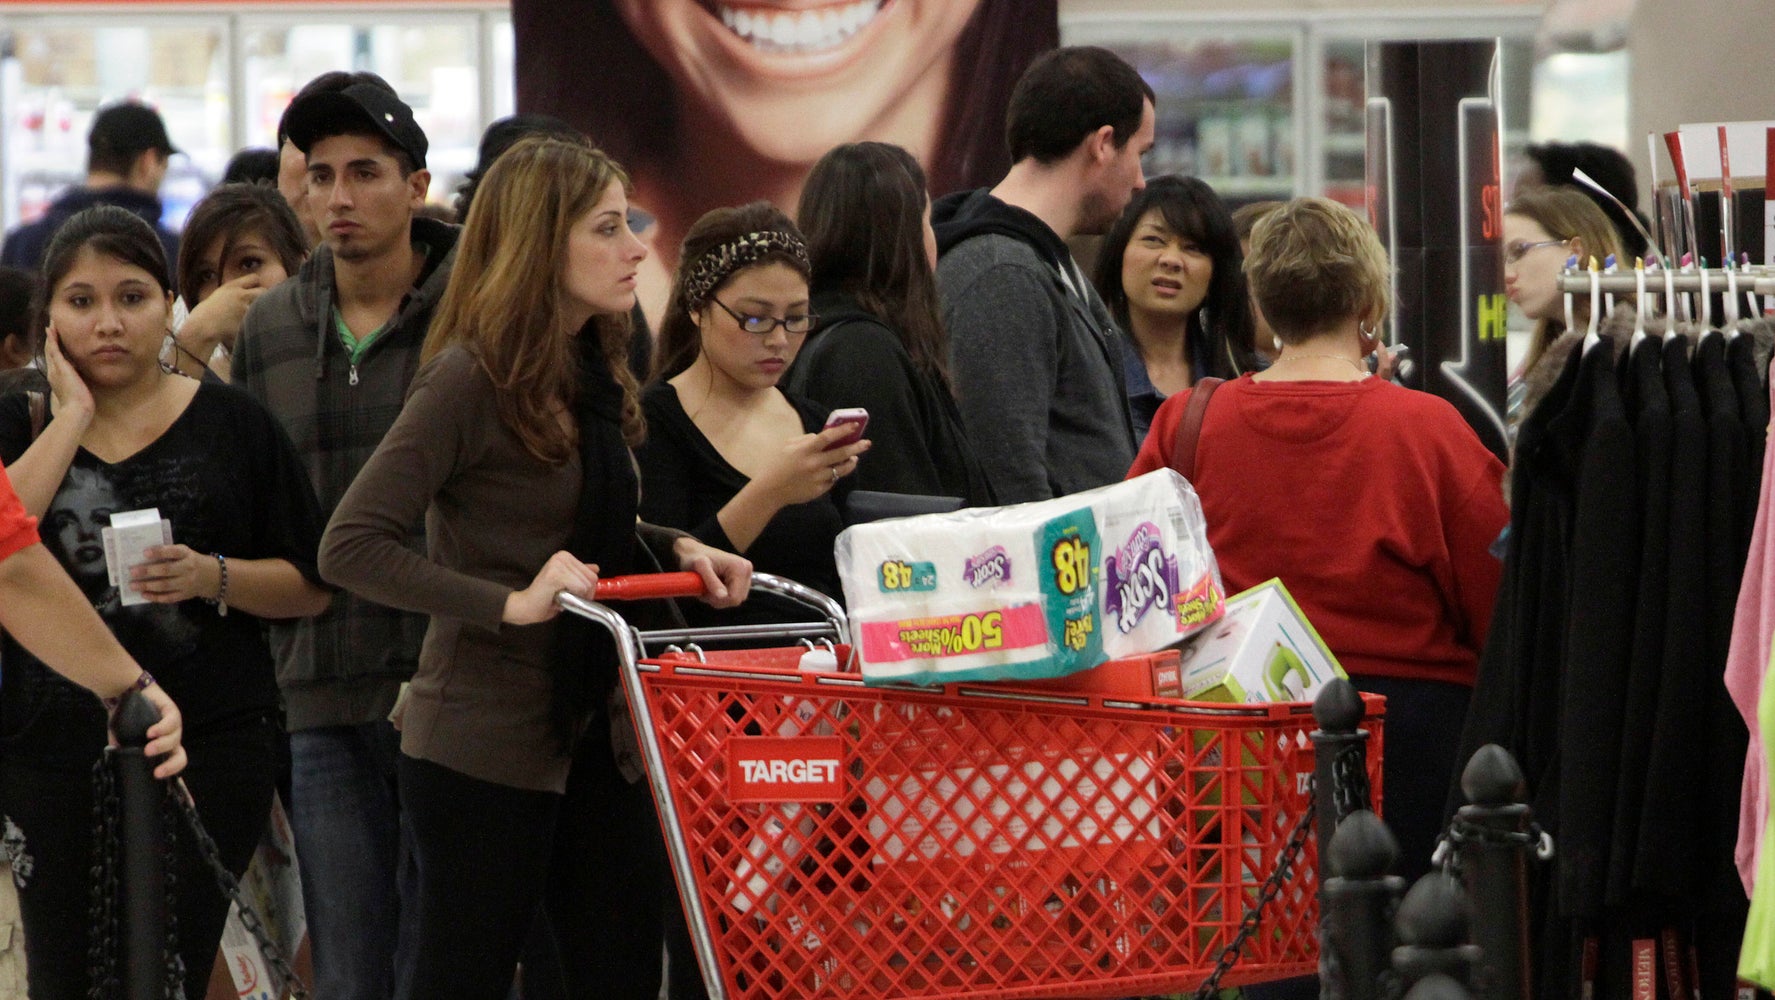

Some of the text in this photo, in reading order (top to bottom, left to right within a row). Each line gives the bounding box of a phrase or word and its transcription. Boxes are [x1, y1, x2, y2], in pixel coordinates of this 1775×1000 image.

[882, 561, 912, 590] 48
[971, 556, 1005, 590] Scott
[1052, 535, 1090, 597] 48
[1117, 548, 1168, 635] Scott
[899, 628, 941, 643] Sheets
[911, 611, 1003, 656] 50% More
[738, 759, 841, 784] TARGET
